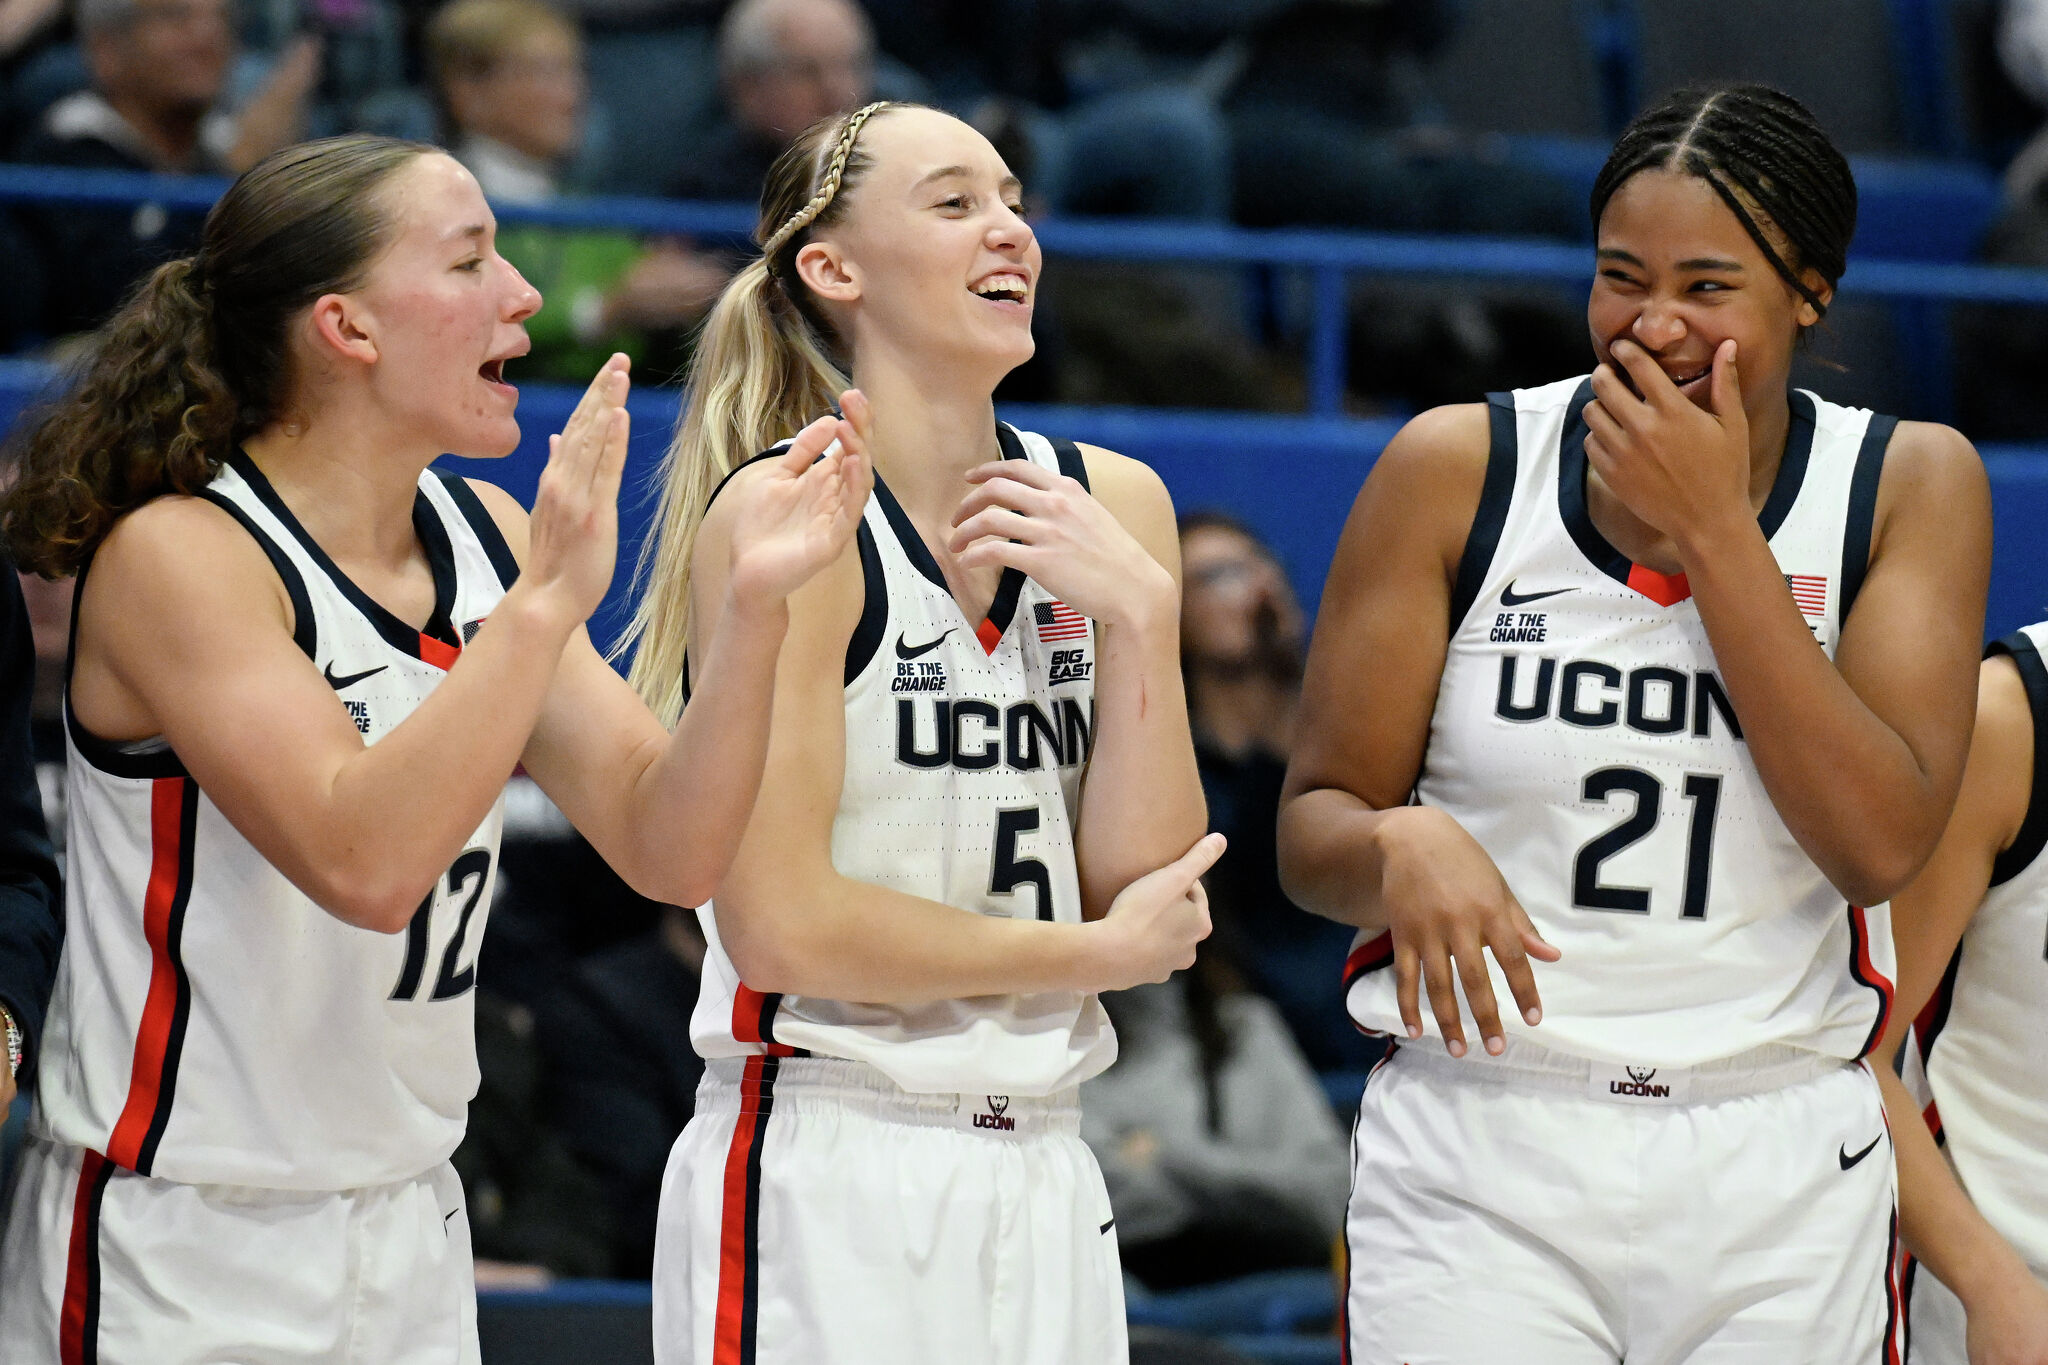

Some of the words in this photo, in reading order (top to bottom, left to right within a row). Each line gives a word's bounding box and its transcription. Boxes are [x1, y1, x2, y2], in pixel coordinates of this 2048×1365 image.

[1495, 613, 1515, 627] BE
[1518, 613, 1547, 627] THE
[1490, 628, 1547, 642] CHANGE
[1051, 649, 1084, 665] BIG
[896, 662, 915, 676] BE
[917, 662, 944, 676] THE
[1049, 662, 1093, 679] EAST
[891, 676, 947, 692] CHANGE
[1495, 653, 1746, 743] UCON
[343, 701, 368, 717] THE
[895, 696, 1094, 774] UCONN
[1572, 764, 1723, 921] 21
[987, 803, 1055, 922] 5
[387, 846, 491, 1002] 12
[1610, 1081, 1670, 1098] UCONN
[973, 1113, 1015, 1131] UCONN
